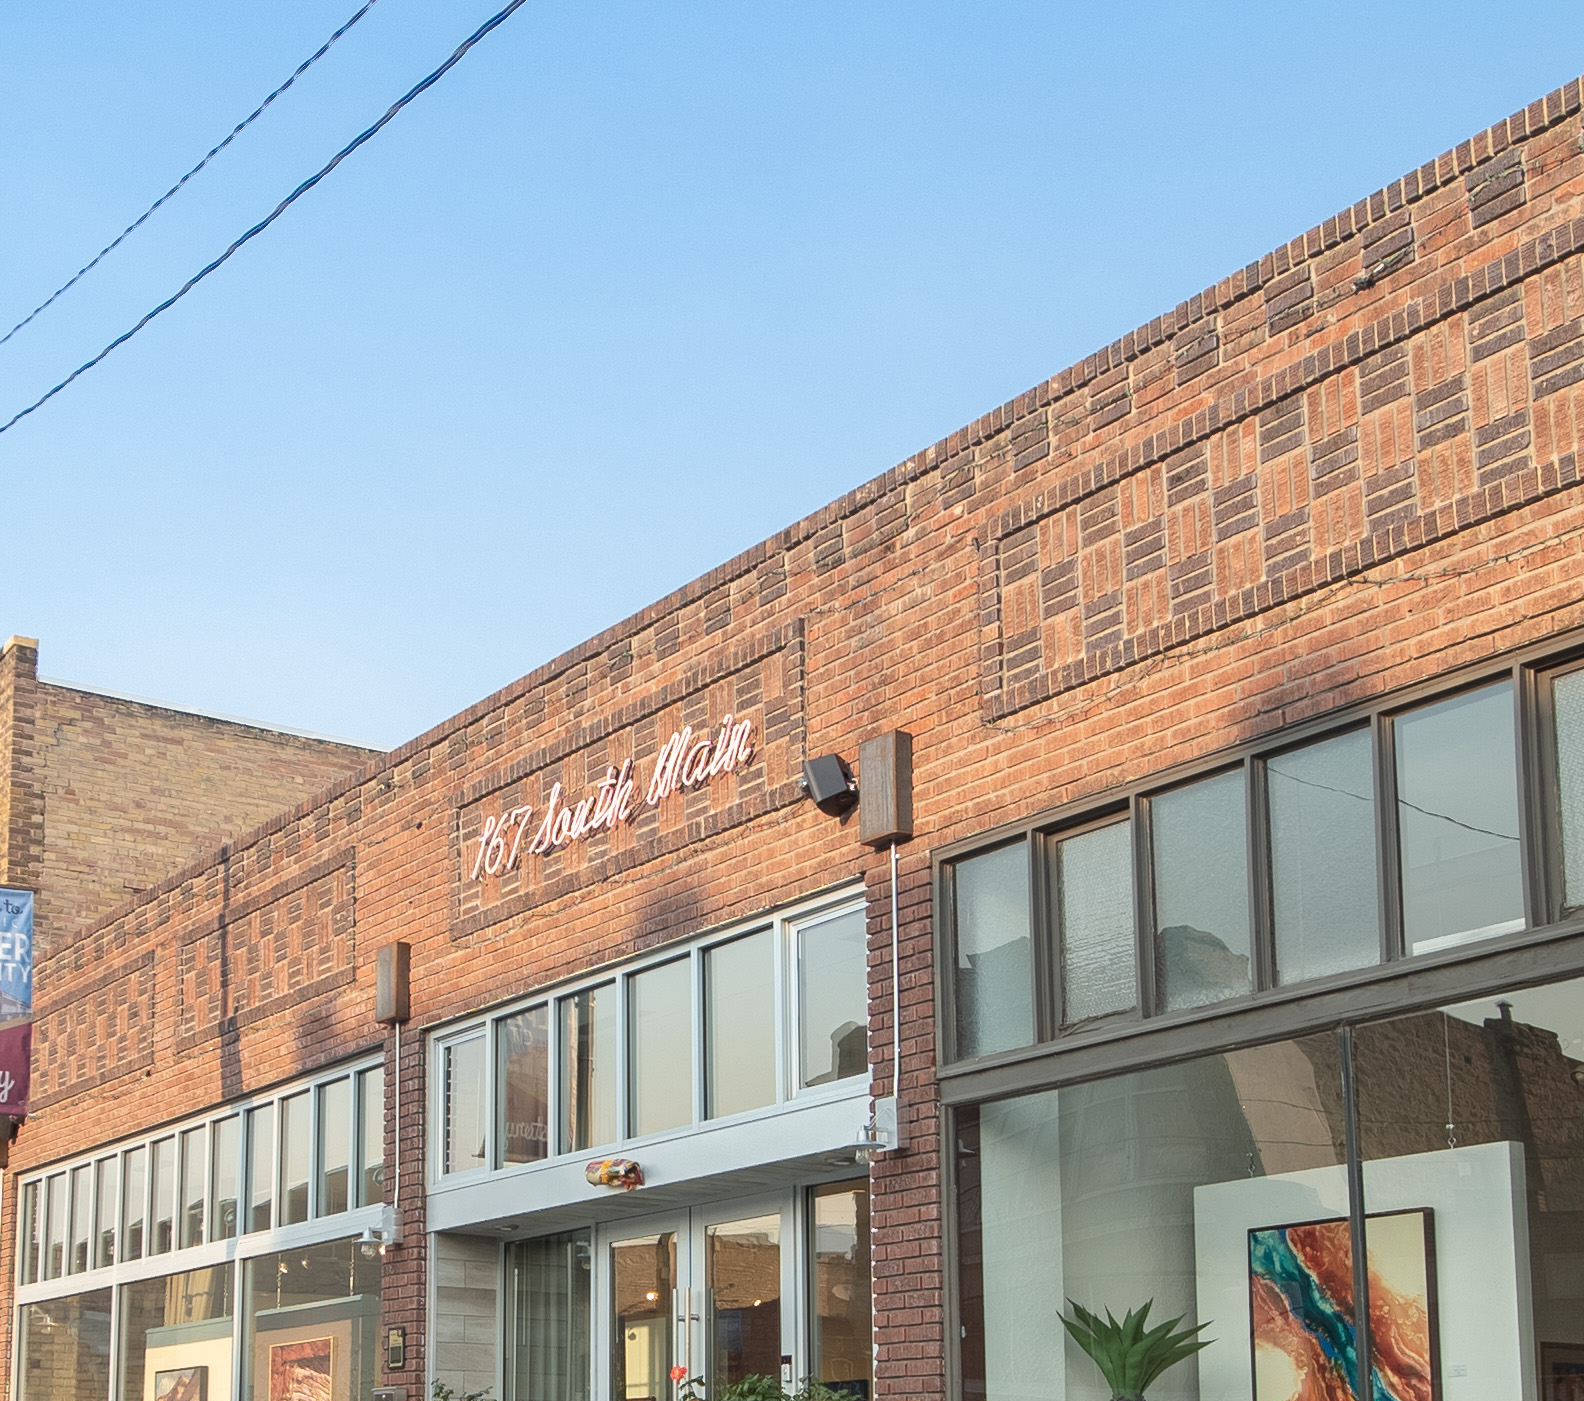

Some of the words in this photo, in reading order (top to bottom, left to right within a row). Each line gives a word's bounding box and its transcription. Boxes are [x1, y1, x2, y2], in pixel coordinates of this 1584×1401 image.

[471, 805, 532, 880] 167
[528, 757, 634, 854] South
[647, 713, 752, 806] Main
[3, 898, 24, 915] to
